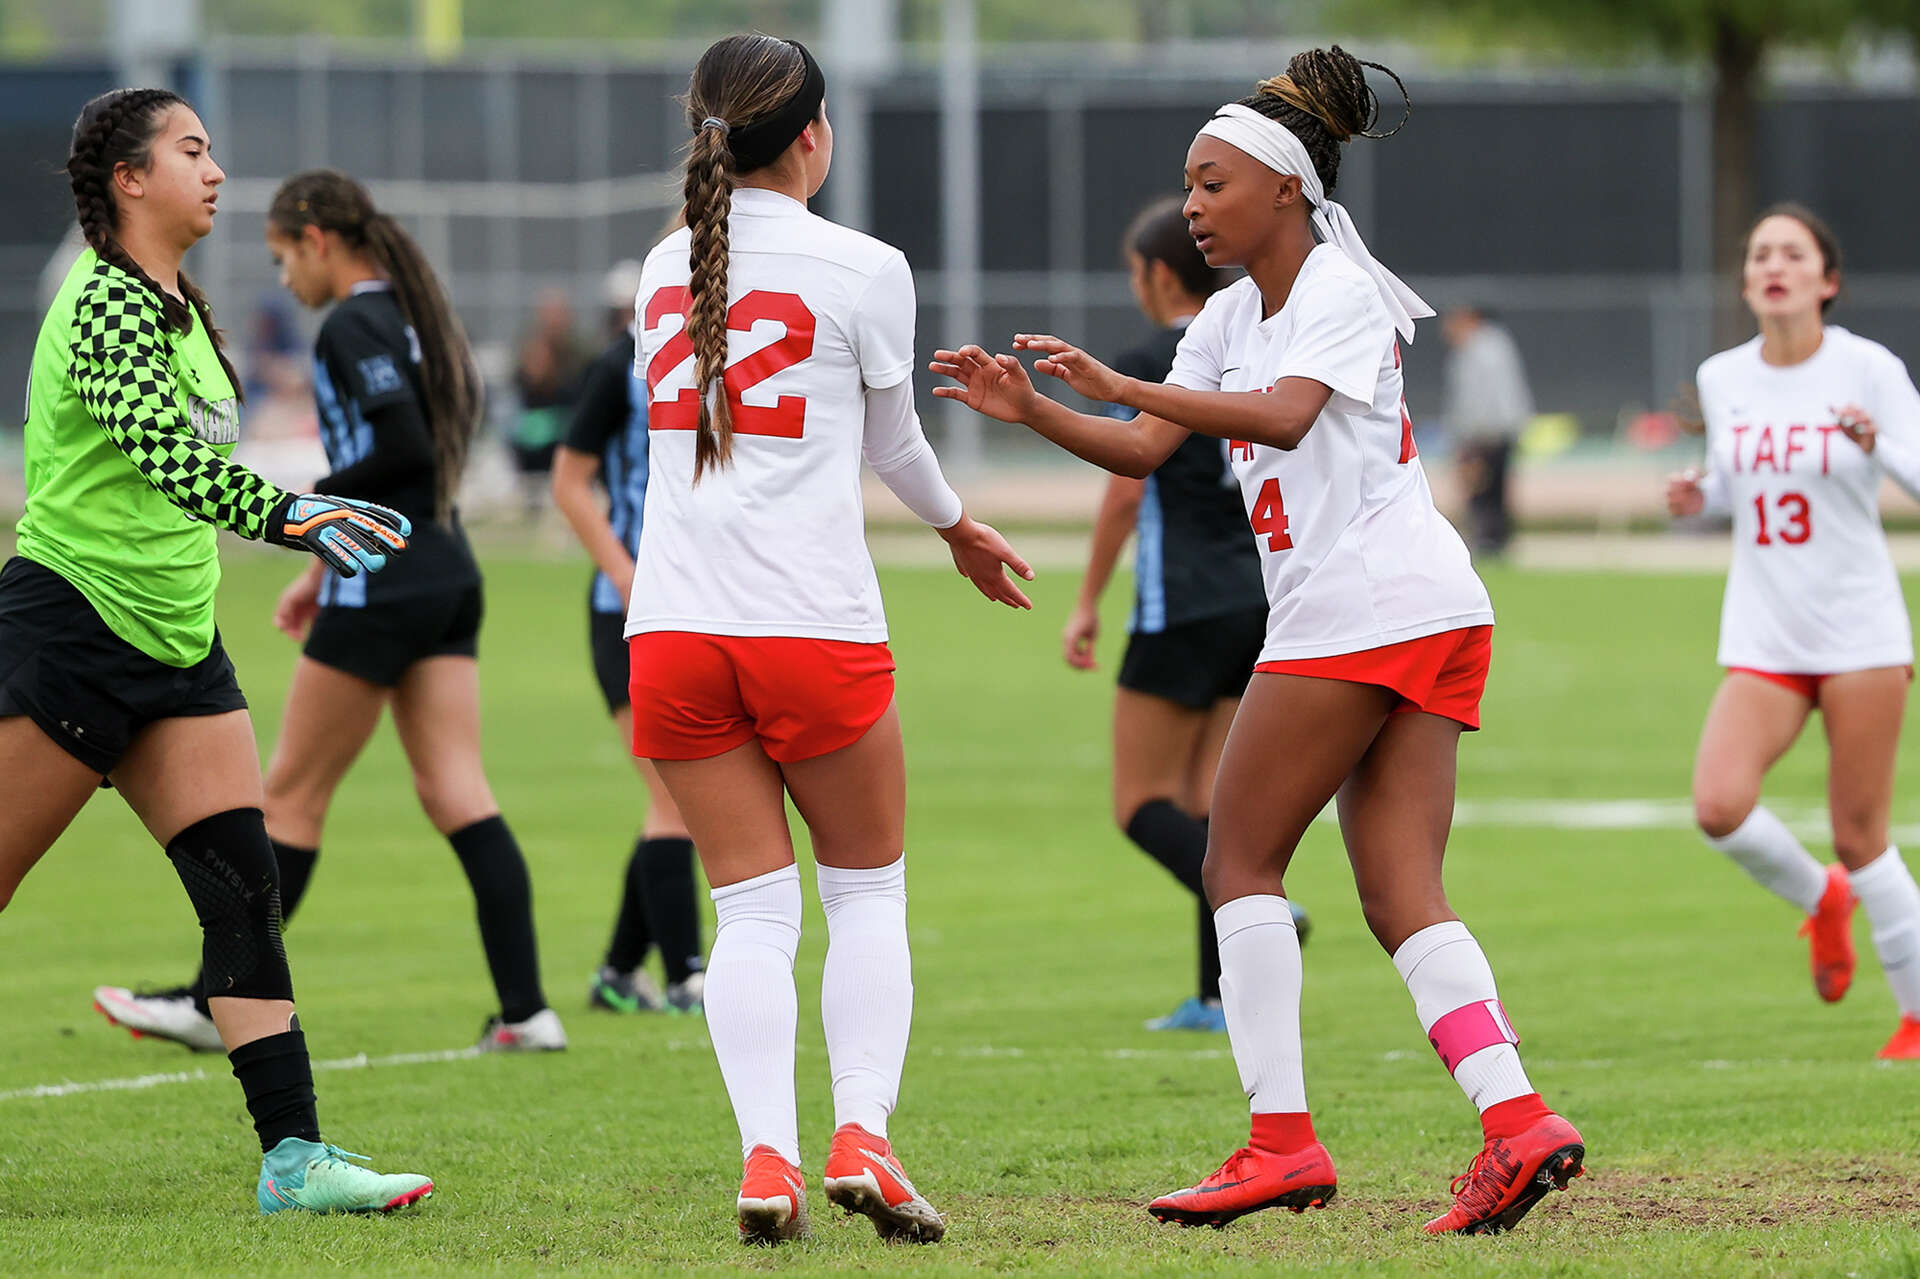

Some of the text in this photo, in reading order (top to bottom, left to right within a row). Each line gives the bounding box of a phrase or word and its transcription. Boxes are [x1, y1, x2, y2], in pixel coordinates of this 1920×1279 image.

[644, 286, 816, 438] 22
[1732, 425, 1840, 476] TAFT
[352, 514, 400, 543] RENEGADE
[1250, 477, 1294, 553] 4
[1754, 491, 1811, 545] 13
[205, 848, 255, 903] PHYSIX
